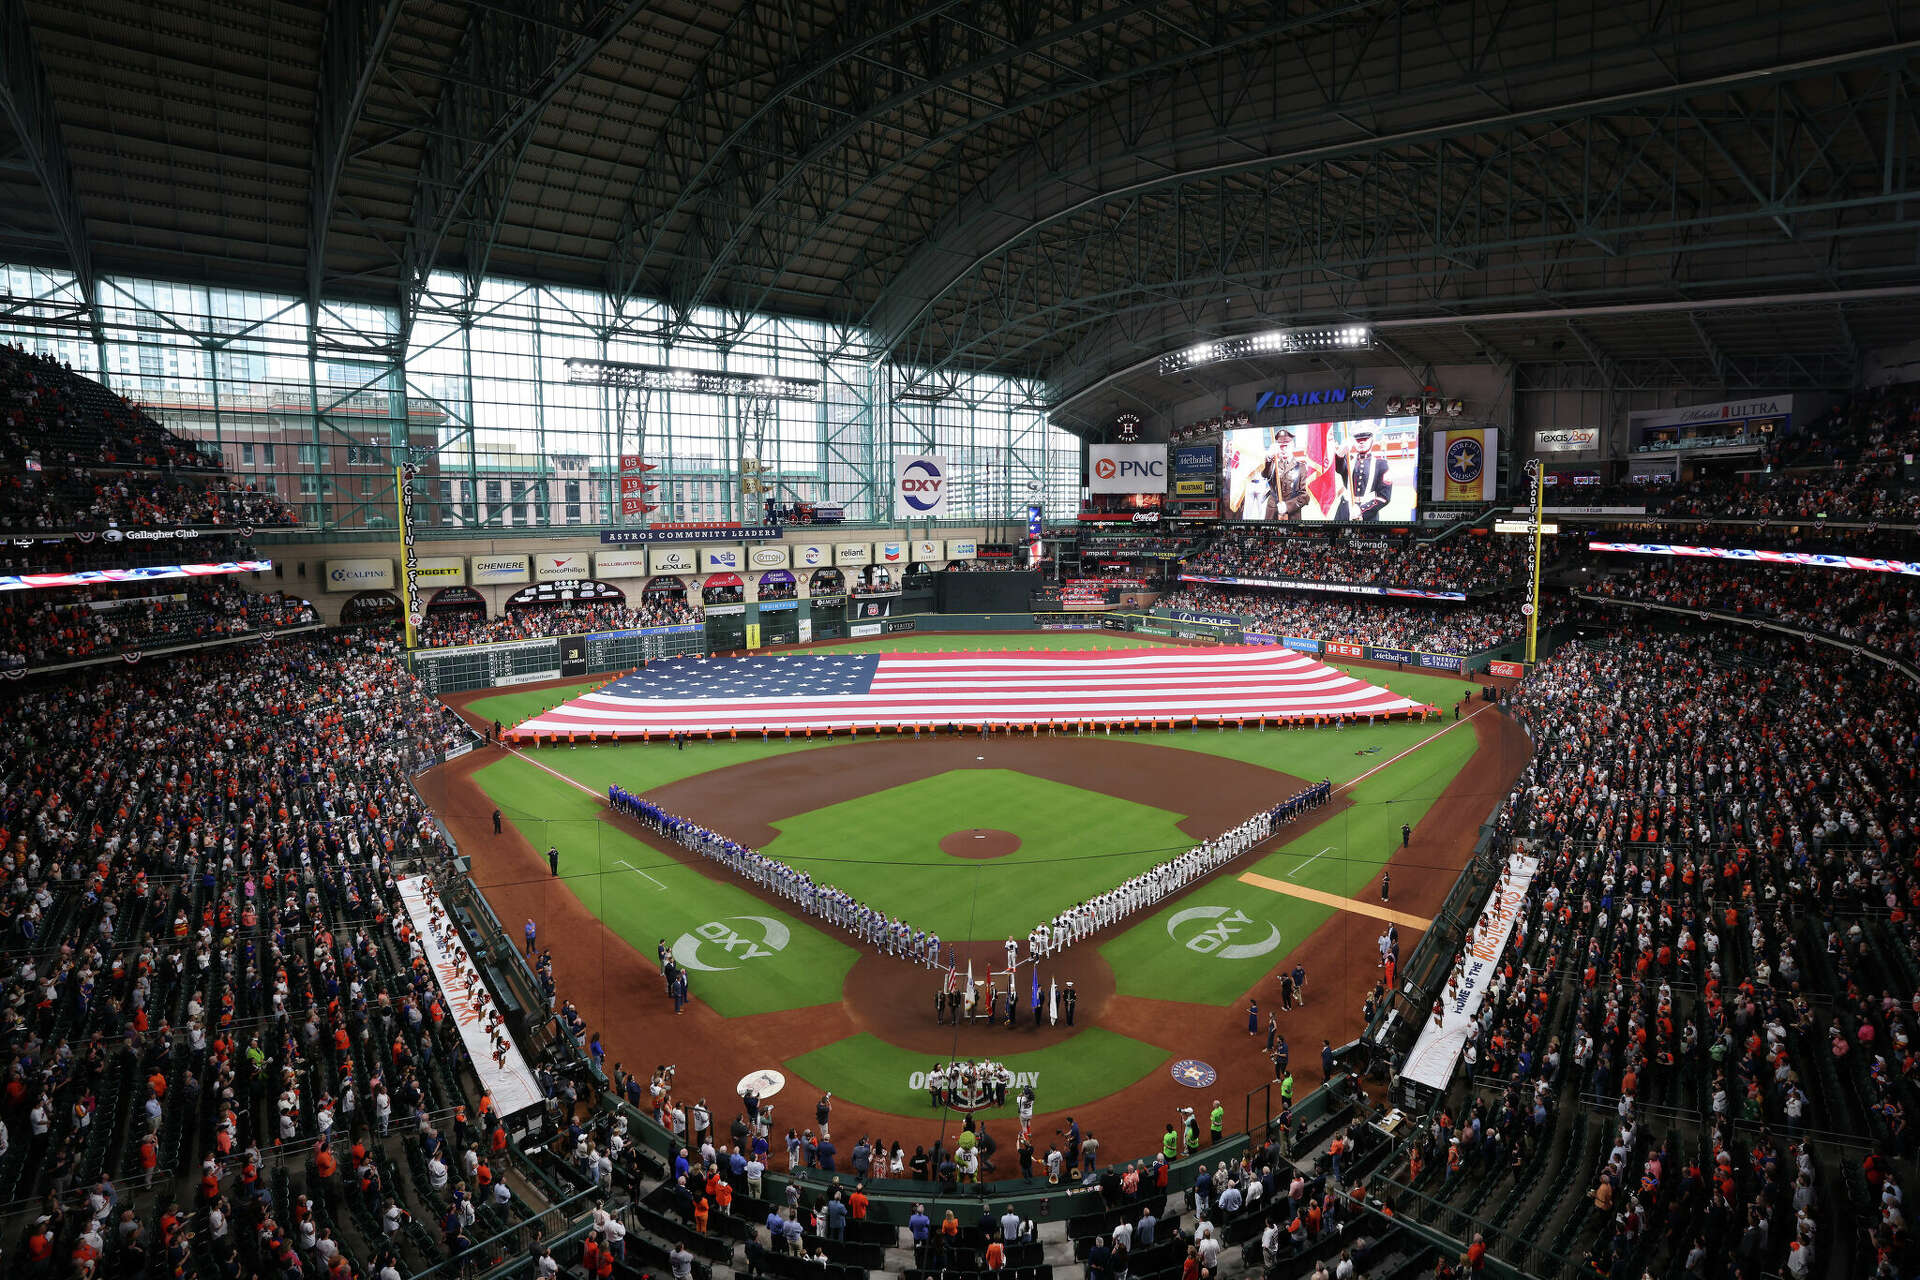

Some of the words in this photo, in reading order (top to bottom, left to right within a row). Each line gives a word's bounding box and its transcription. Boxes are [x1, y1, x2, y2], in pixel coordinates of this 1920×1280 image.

[1273, 388, 1347, 408] DAIKIN
[1351, 388, 1374, 398] PARK
[1731, 401, 1779, 417] ULTRA
[1123, 423, 1134, 434] H
[1539, 432, 1568, 443] Texas
[1570, 430, 1594, 445] Bay
[624, 458, 637, 467] 05
[1179, 454, 1212, 465] Methodist
[1120, 460, 1163, 477] PNC
[626, 480, 638, 488] 19
[902, 479, 942, 491] OXY
[1529, 480, 1537, 513] ROOT
[626, 501, 638, 509] 21
[404, 485, 414, 545] CHIKIN
[1132, 511, 1160, 522] Coca-Cola
[126, 530, 174, 540] Gallagher
[175, 529, 198, 539] Club
[609, 533, 653, 541] ASTROS
[659, 531, 728, 539] COMMUNITY
[731, 529, 776, 537] LEADERS
[1527, 527, 1536, 552] THA
[406, 548, 417, 567] IZ
[840, 548, 864, 557] reliant
[1087, 549, 1110, 557] impact
[1117, 549, 1140, 557] impact
[477, 561, 525, 570] CHENIERE
[539, 567, 586, 575] ConocoPhillips
[347, 570, 387, 578] CALPINE
[417, 568, 459, 576] OGGETT
[1526, 554, 1536, 603] CHIKIN
[408, 570, 419, 612] FAIR
[353, 598, 396, 607] MAVEN
[1193, 616, 1231, 625] LEXUS
[1327, 645, 1361, 655] H-E-B
[1375, 653, 1409, 663] Methodist
[1432, 655, 1458, 663] ENERGY
[1186, 909, 1255, 953] OXY
[695, 921, 773, 960] OXY
[1454, 988, 1469, 1014] HOME
[1471, 961, 1483, 977] THE
